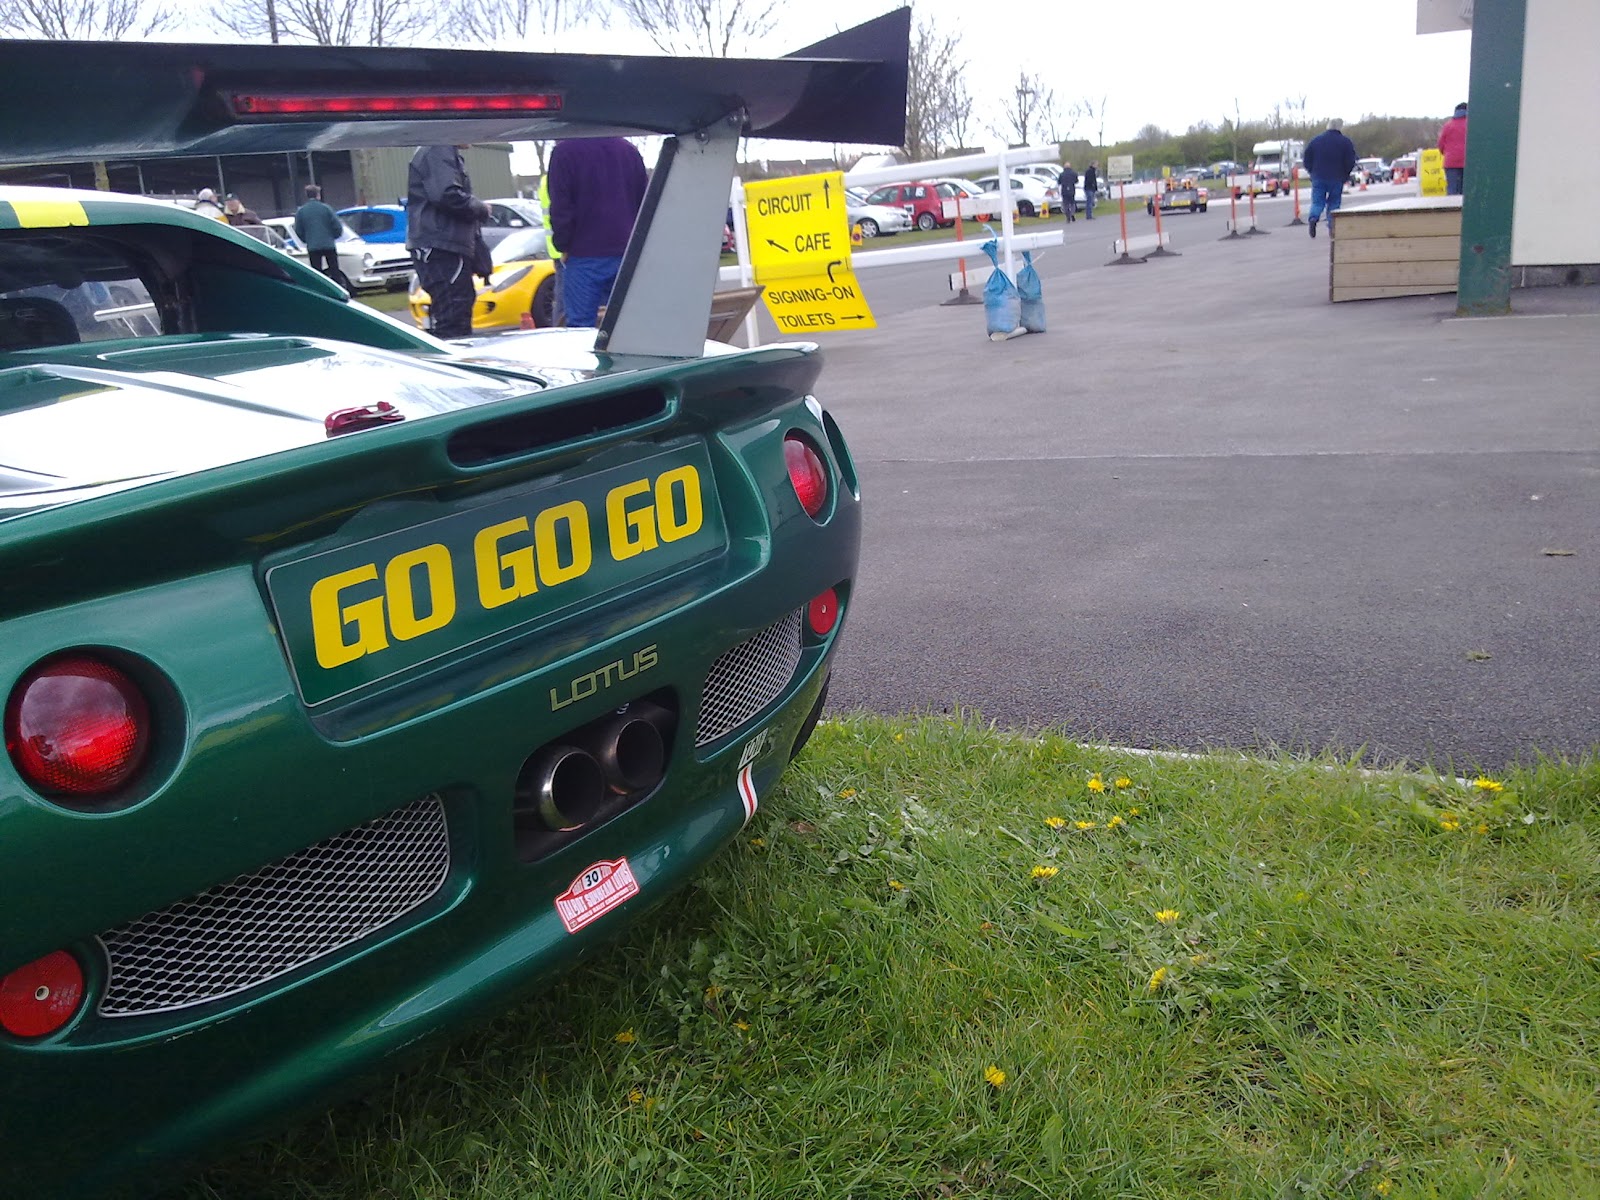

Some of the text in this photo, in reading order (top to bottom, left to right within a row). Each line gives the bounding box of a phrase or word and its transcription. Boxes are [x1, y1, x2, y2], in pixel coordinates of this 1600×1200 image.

[757, 193, 812, 217] CIRCUIT
[794, 232, 832, 253] CAFE
[768, 285, 855, 305] SIGNING-ON
[778, 312, 836, 328] TOILETS
[310, 464, 703, 669] GO GO GO
[550, 643, 659, 712] LOTUS
[585, 870, 599, 886] 30
